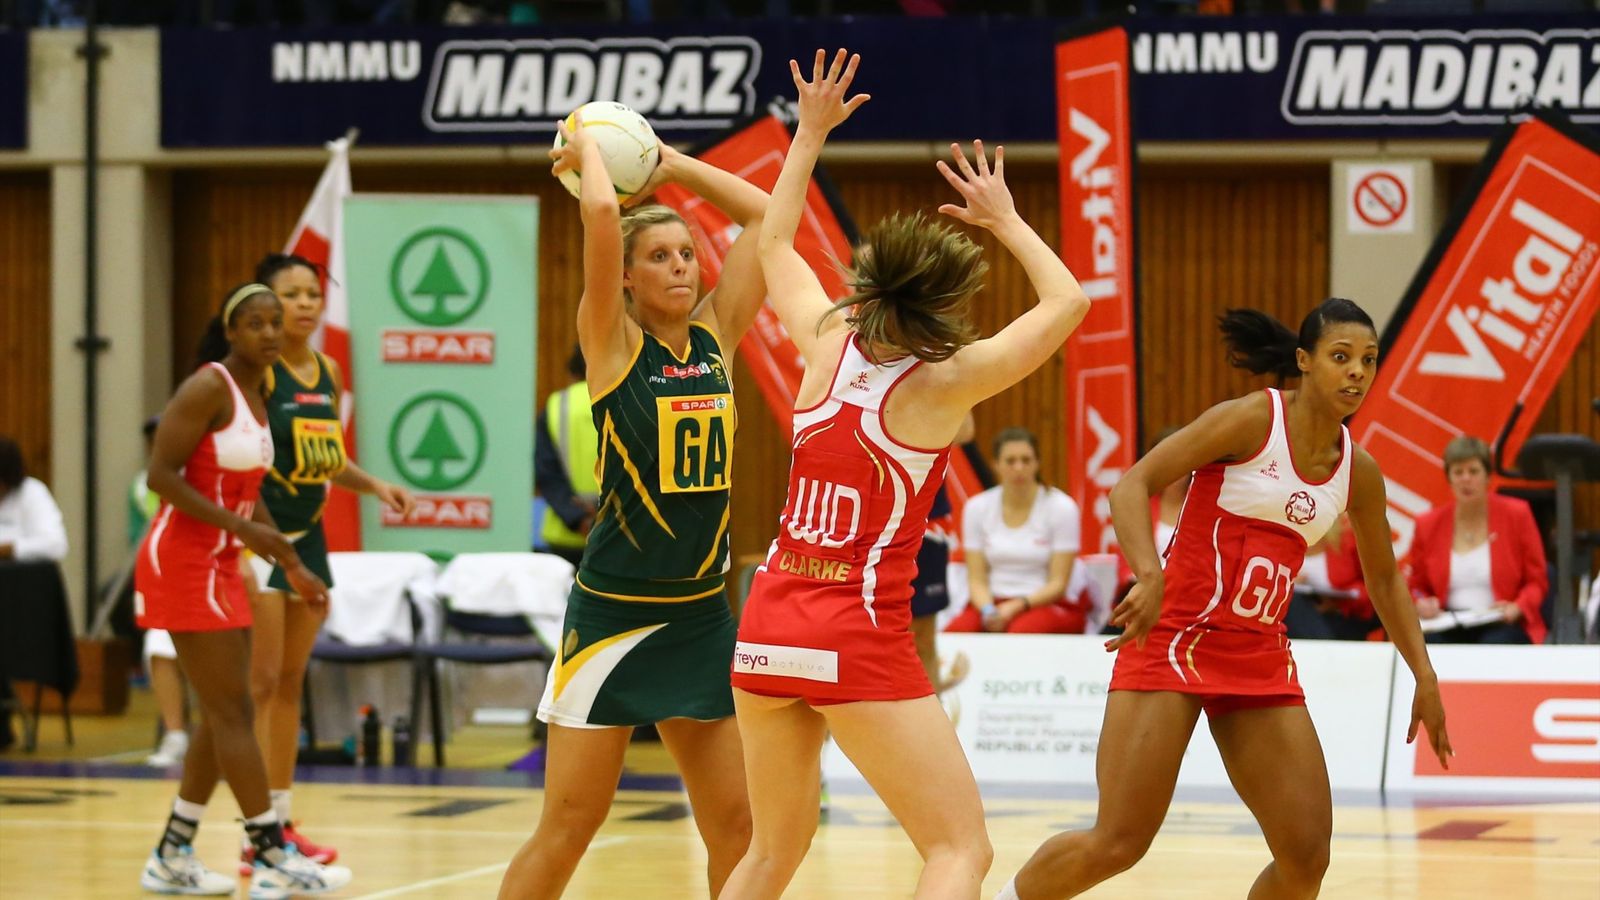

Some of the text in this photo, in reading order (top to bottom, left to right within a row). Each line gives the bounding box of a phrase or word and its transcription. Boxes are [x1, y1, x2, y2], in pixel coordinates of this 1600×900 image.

[272, 41, 749, 117] NMMU MADIBAZ
[1417, 197, 1584, 382] Vital
[383, 332, 493, 361] SPAR
[681, 401, 715, 410] SPAR
[673, 415, 727, 489] GA
[787, 476, 862, 549] WD
[778, 550, 852, 584] CLARKE
[1231, 555, 1293, 626] GD
[770, 660, 825, 673] active
[982, 678, 1043, 700] sport
[1052, 676, 1068, 696] &
[974, 740, 1049, 754] REPUBLIC
[1053, 741, 1073, 754] OF
